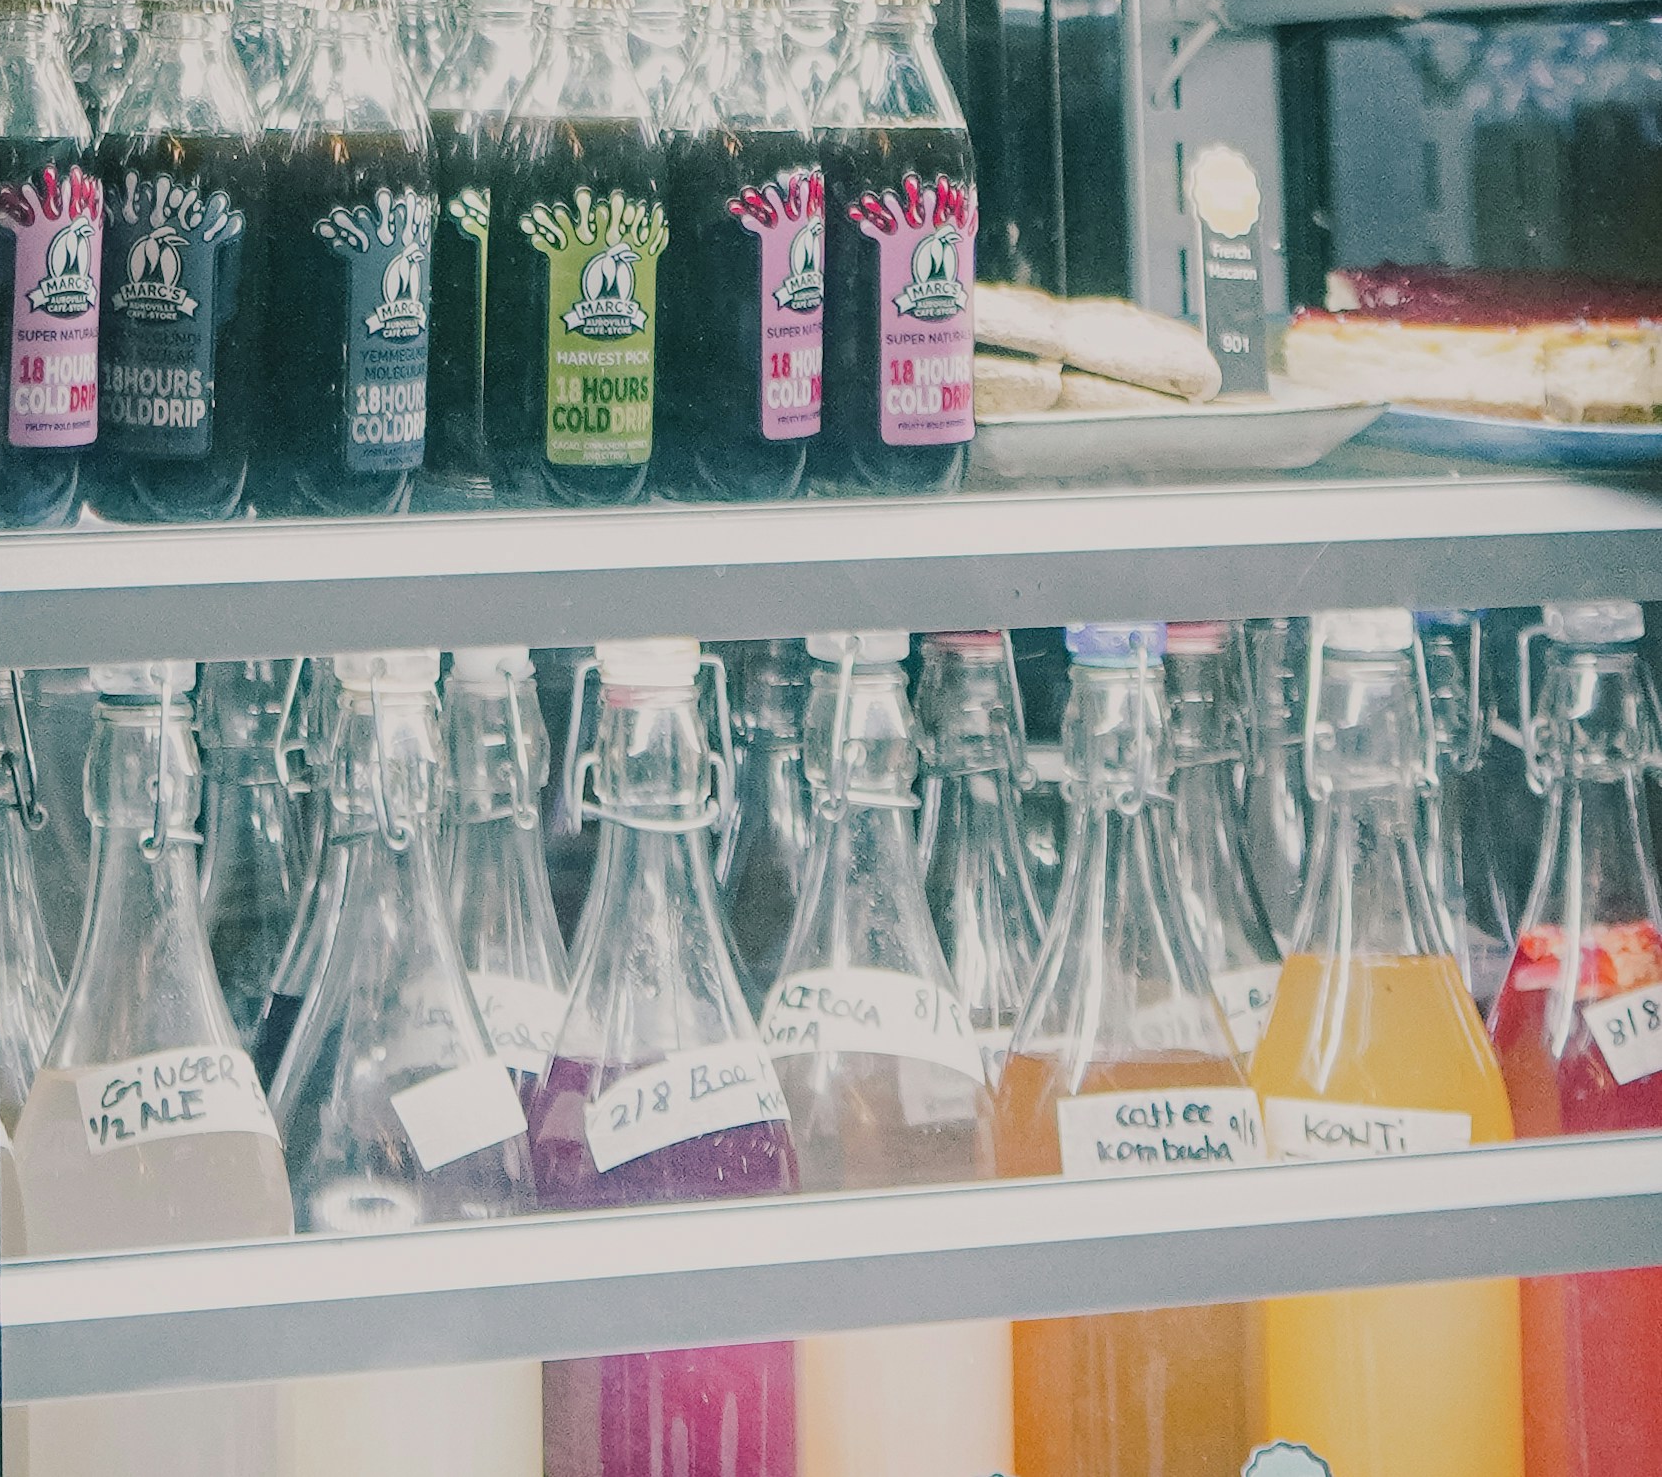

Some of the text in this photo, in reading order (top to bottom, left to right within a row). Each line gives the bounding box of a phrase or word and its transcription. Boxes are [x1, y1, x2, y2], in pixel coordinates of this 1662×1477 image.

[1211, 243, 1252, 260] French
[1208, 262, 1258, 281] Macaron
[45, 277, 90, 293] MARC'S
[124, 285, 180, 300] MARC'S
[913, 283, 959, 298] MARC'S
[381, 300, 422, 318] MARC'S
[582, 301, 635, 315] MARC'S
[587, 317, 631, 327] AUROVILLE
[17, 329, 57, 342] SUPER
[767, 324, 801, 339] SUPER
[886, 333, 926, 345] SUPER
[557, 351, 650, 366] HARVEST PICK
[1606, 999, 1659, 1046] 8/8
[610, 1080, 671, 1131] 2/8
[90, 1089, 207, 1145] 1/2 ALE
